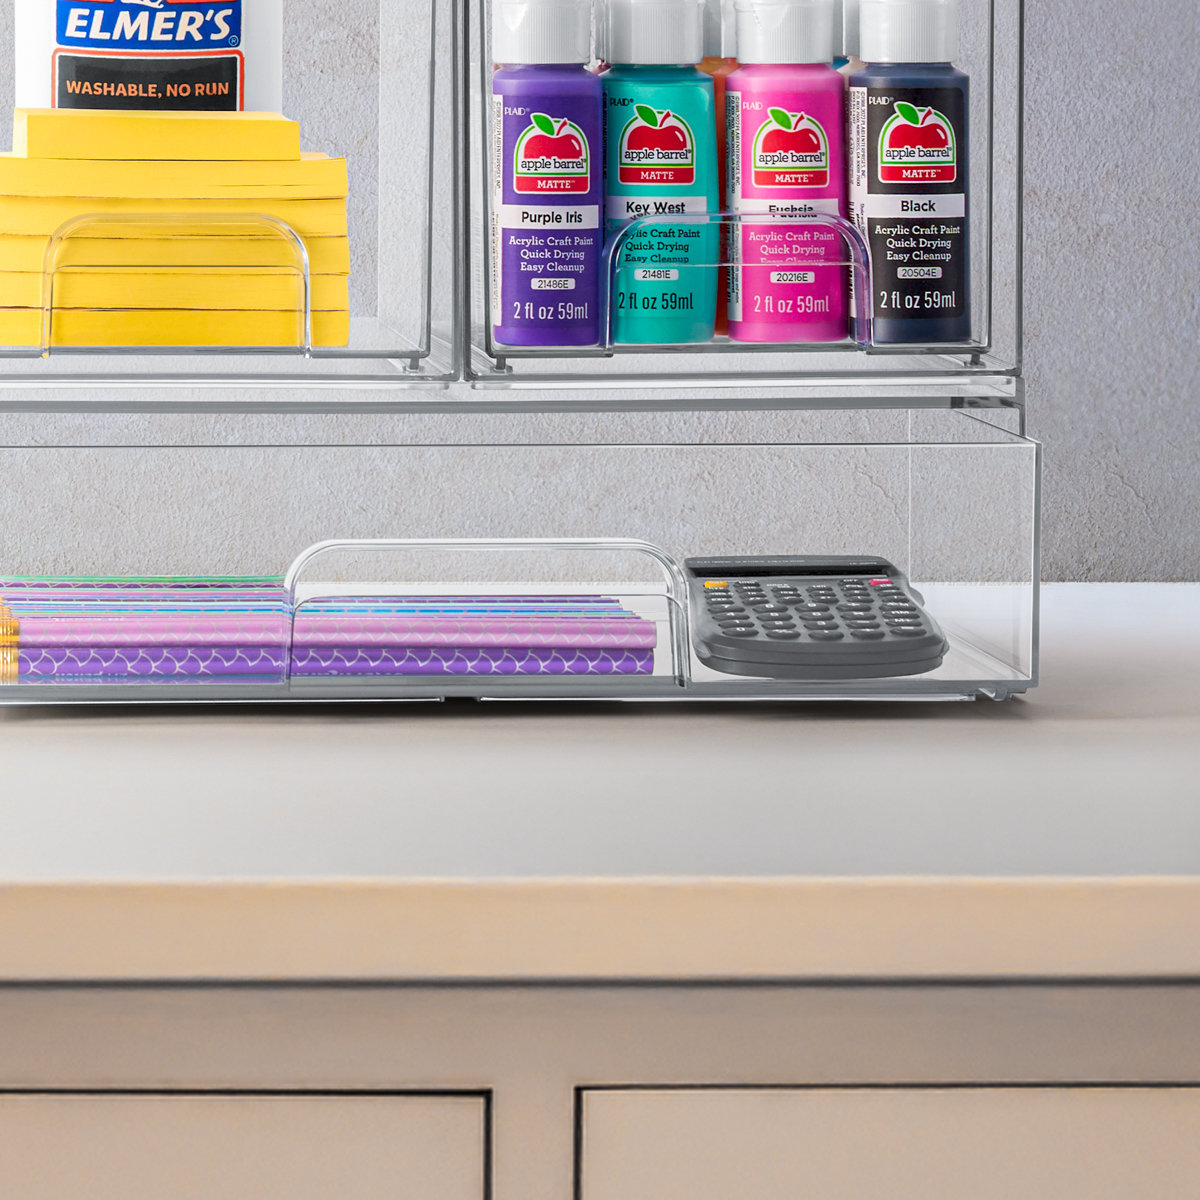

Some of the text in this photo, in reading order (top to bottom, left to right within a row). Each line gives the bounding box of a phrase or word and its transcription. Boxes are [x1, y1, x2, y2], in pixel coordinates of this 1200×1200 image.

[65, 8, 232, 41] ELMER'S
[66, 80, 229, 98] WASHABLE, NO RUN
[624, 149, 688, 161] apple barrel
[759, 152, 822, 165] apple barrel
[885, 147, 950, 160] apple barrel
[521, 158, 584, 171] apple barrel
[640, 171, 674, 180] MATTE
[775, 174, 808, 183] MATTE
[902, 169, 936, 178] MATTE
[537, 180, 572, 189] MATTE
[626, 201, 685, 213] Key West
[901, 200, 936, 212] Black
[521, 211, 583, 226] Purple Iris
[650, 229, 675, 237] Craft
[678, 229, 700, 237] Paint
[875, 225, 960, 235] Acrylic Craft Paint
[509, 236, 593, 247] Acrylic Craft Paint
[749, 232, 834, 242] Acrylic Craft Paint
[625, 241, 689, 252] Quick Drying
[886, 238, 952, 250] Quick Drying
[520, 249, 585, 261] Quick Drying
[760, 245, 825, 255] Quick Drying
[625, 254, 689, 263] Easy Cleanup
[886, 251, 952, 262] Easy Cleanup
[520, 263, 585, 273] Easy Cleanup
[902, 269, 937, 277] 20504E
[642, 270, 671, 278] 21481E
[777, 273, 808, 282] 20216E
[537, 280, 569, 288] 21486E
[618, 293, 693, 310] 2 fl oz 59ml
[754, 295, 830, 313] 2 fl oz 59ml
[880, 291, 956, 308] 2 fl oz 59ml
[514, 302, 588, 319] 2 fl oz 59ml
